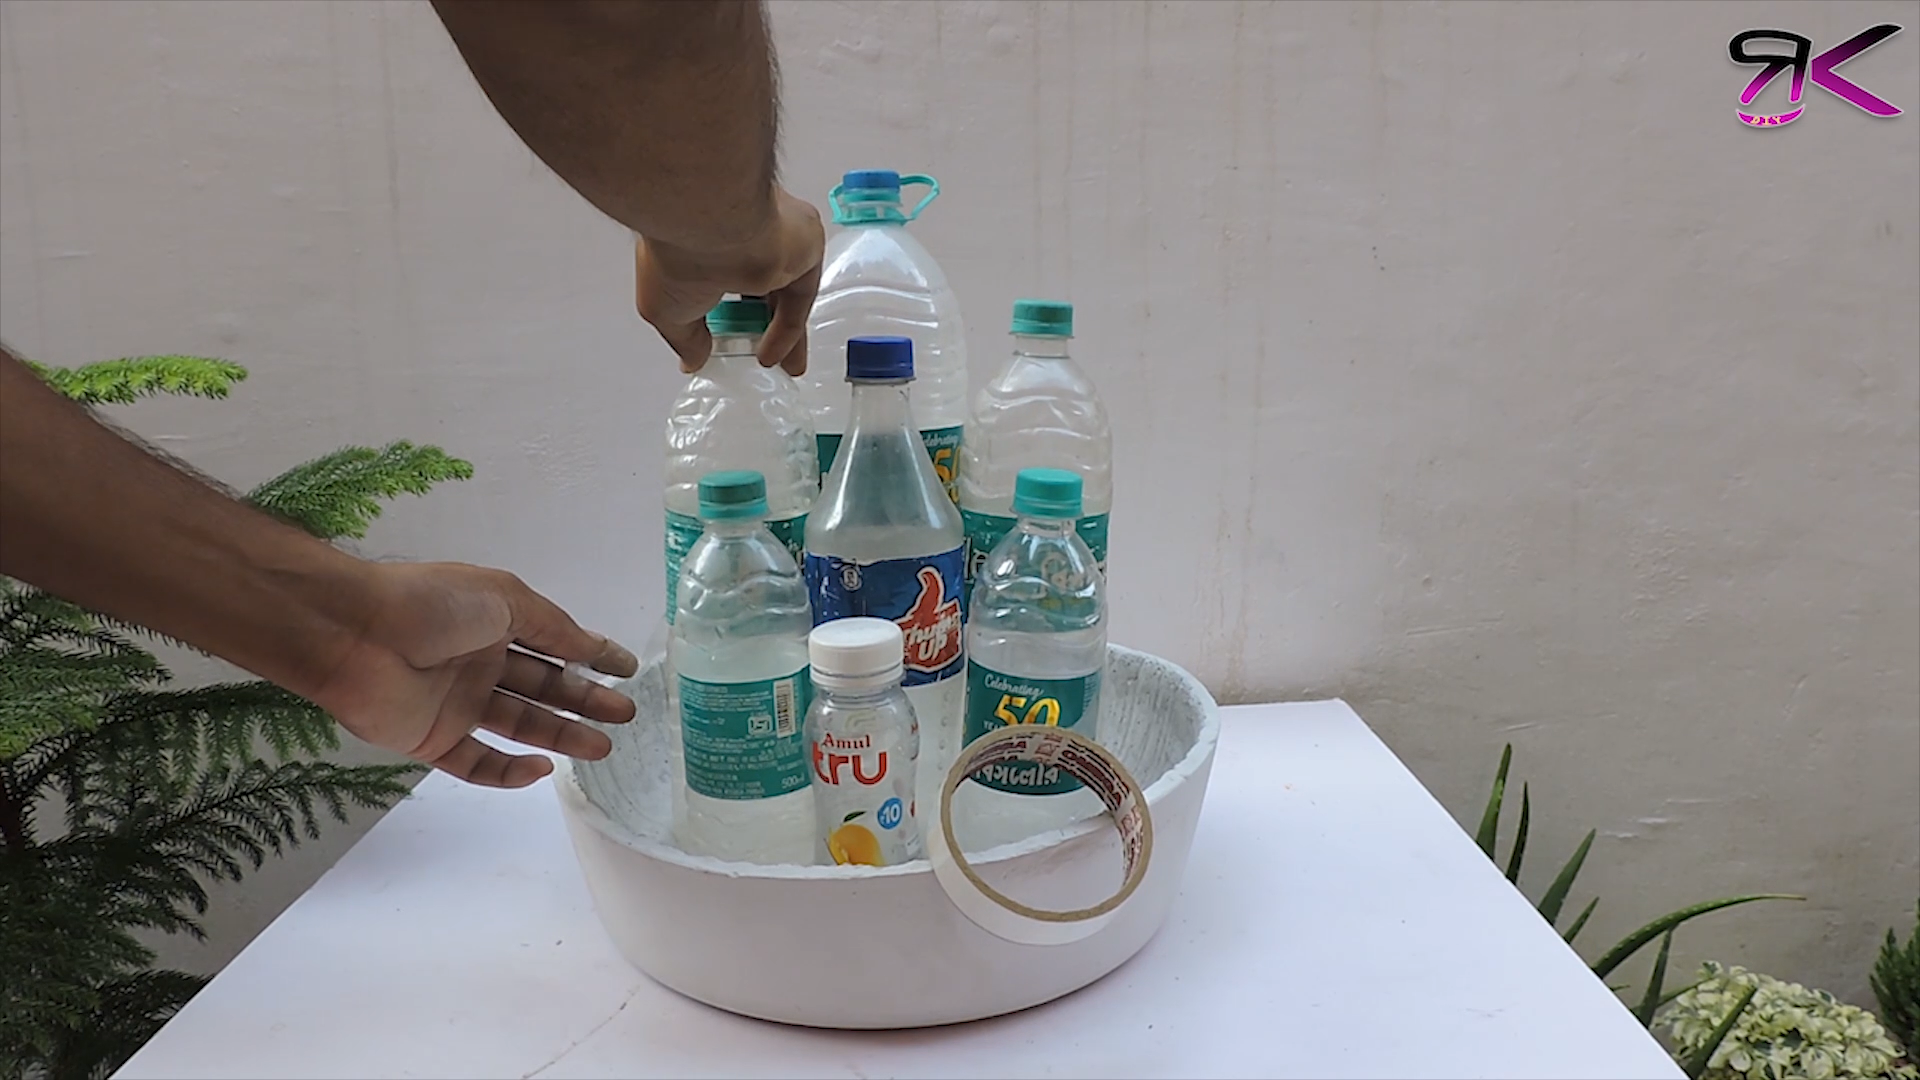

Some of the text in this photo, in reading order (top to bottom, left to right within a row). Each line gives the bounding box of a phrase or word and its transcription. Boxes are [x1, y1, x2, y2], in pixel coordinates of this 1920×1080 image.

[922, 433, 958, 449] elebrating
[984, 673, 1045, 700] Celebrating
[993, 693, 1061, 727] 50
[821, 732, 871, 749] Amul
[812, 741, 888, 786] tru
